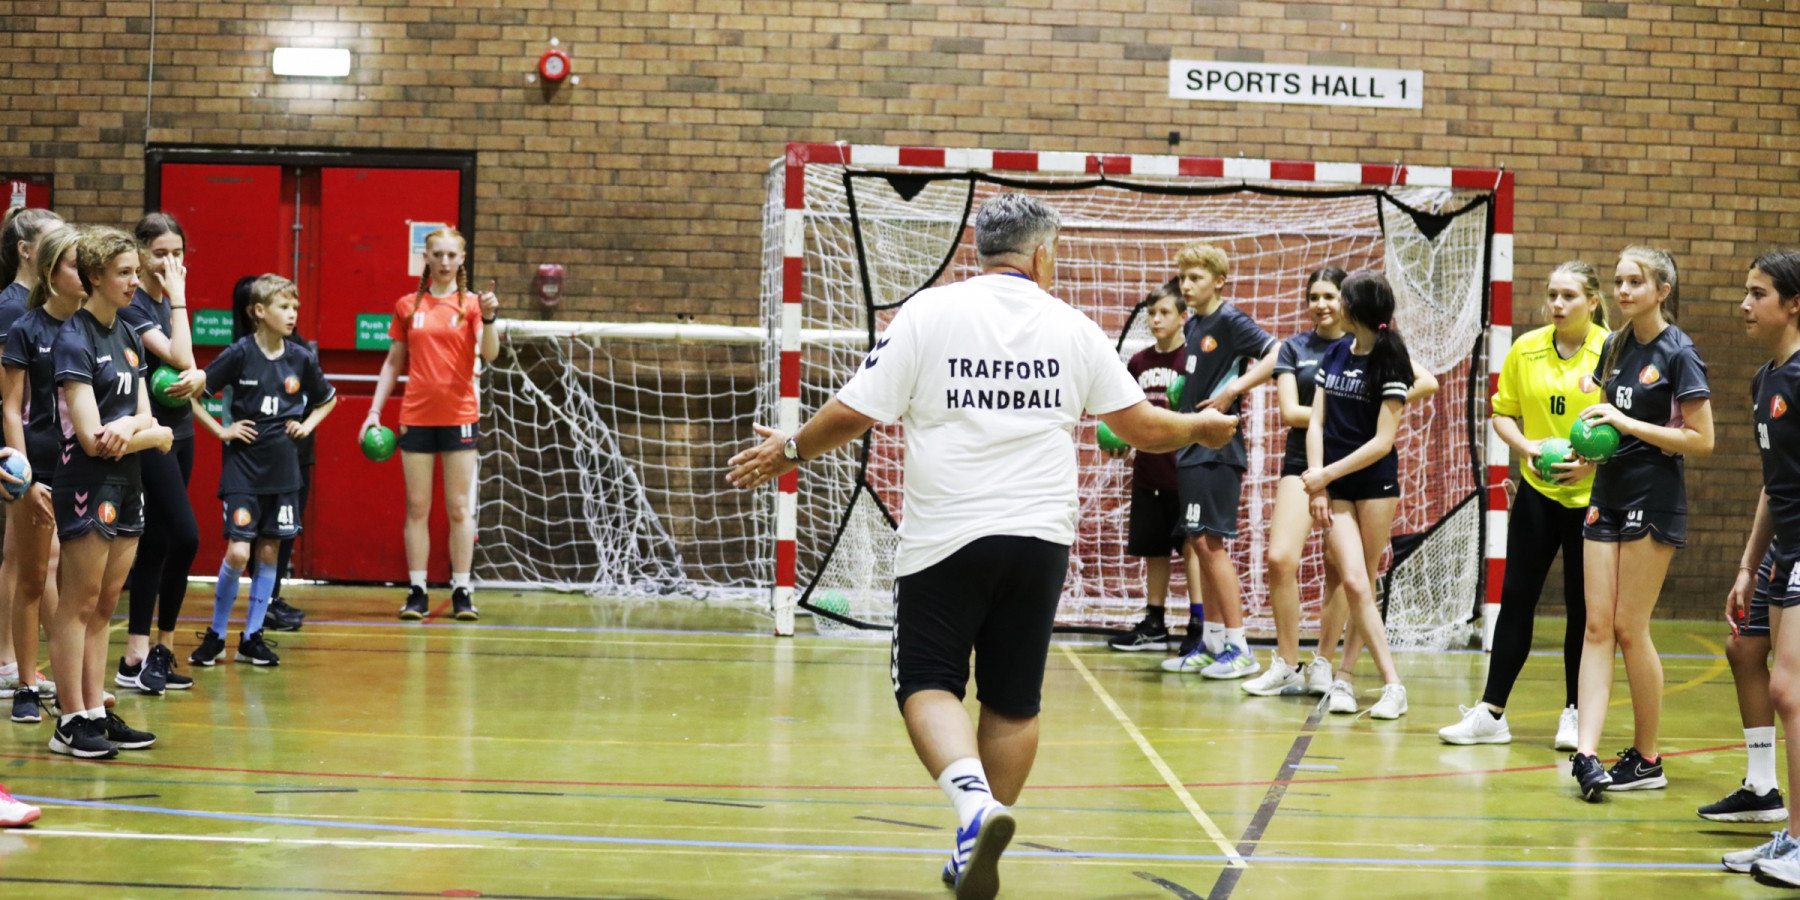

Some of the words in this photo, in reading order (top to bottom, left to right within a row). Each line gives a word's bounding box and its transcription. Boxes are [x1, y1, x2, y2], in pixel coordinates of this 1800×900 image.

[1186, 69, 1301, 95] SPORTS
[1311, 75, 1385, 98] HALL
[1397, 78, 1408, 99] 1
[196, 316, 219, 325] Push
[360, 320, 383, 329] Push
[196, 327, 206, 336] to
[209, 328, 232, 337] open
[360, 331, 370, 339] to
[947, 358, 1061, 380] TRAFFORD
[116, 371, 133, 395] 70
[260, 395, 279, 416] 41
[946, 388, 1062, 410] HANDBALL
[1549, 395, 1566, 416] 16
[1615, 385, 1633, 410] 53
[277, 505, 294, 525] 41
